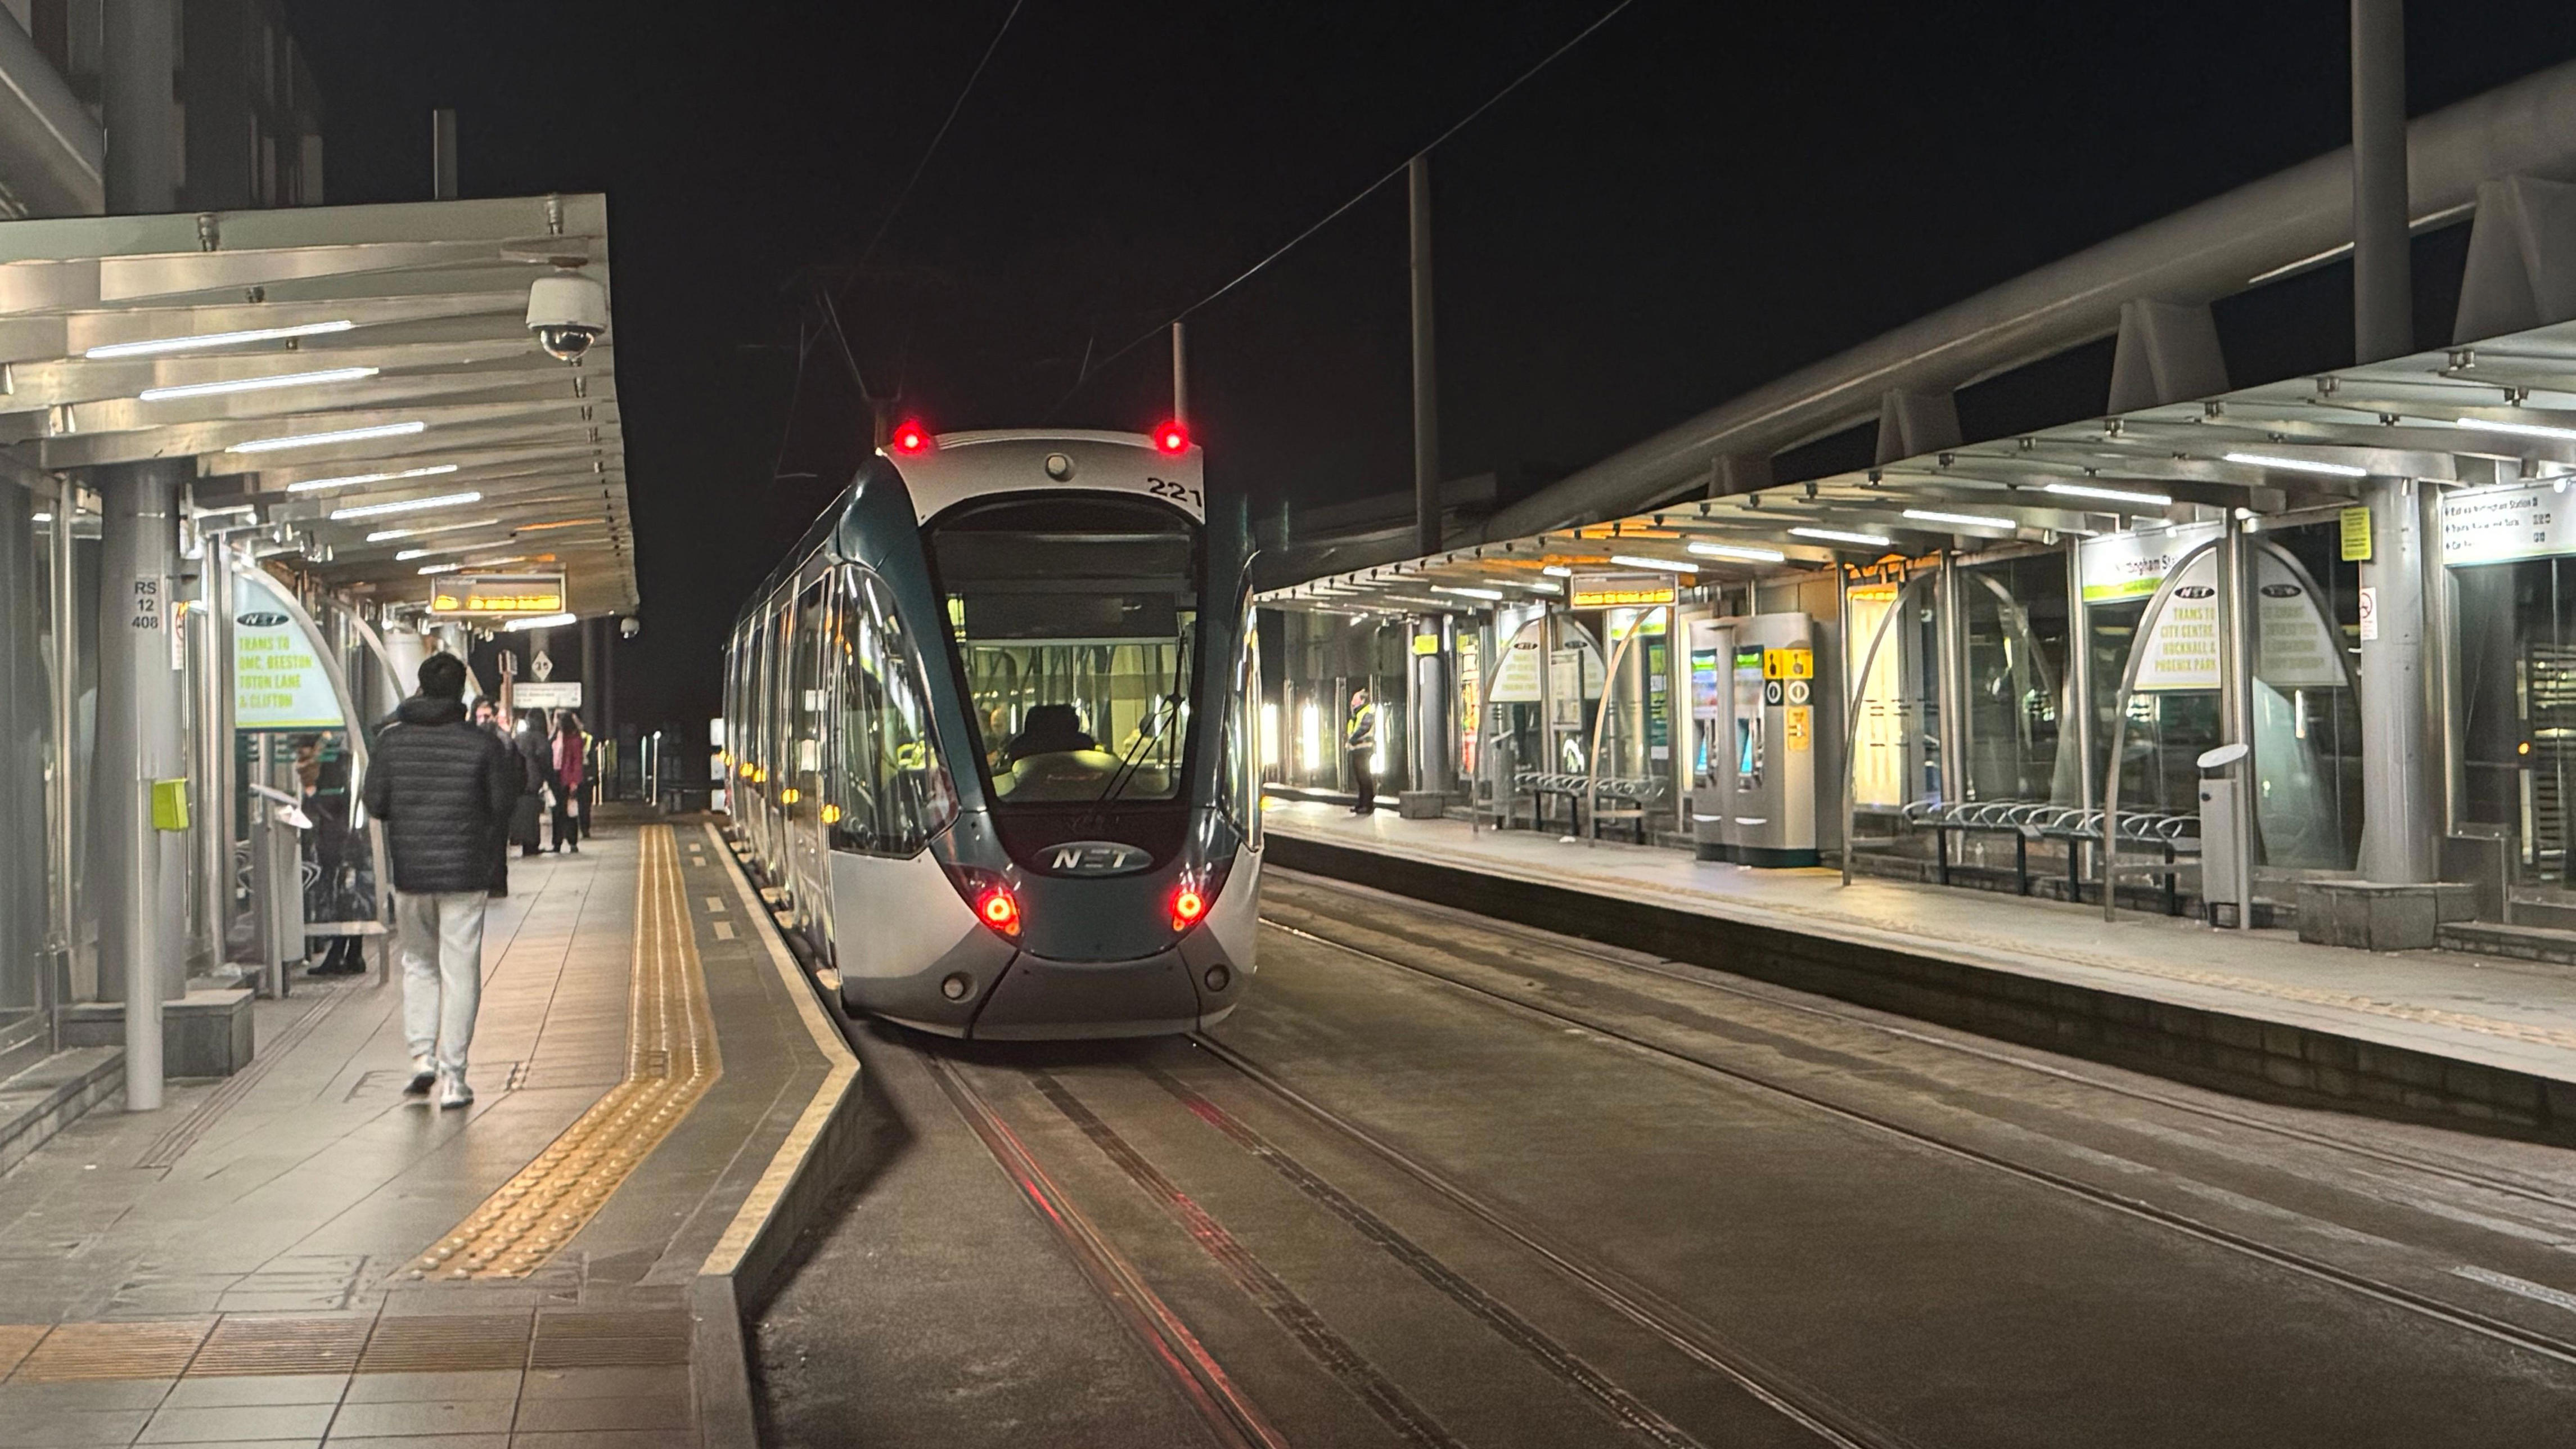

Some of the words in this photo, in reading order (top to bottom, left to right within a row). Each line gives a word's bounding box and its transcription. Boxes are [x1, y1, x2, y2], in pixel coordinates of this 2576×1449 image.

[1147, 478, 1202, 507] 221
[135, 581, 156, 594] RS
[138, 598, 154, 611] 12
[2174, 607, 2203, 620] TRAMS
[131, 616, 158, 628] 408
[2160, 625, 2178, 638] CITY
[238, 636, 273, 650] TRAMS
[274, 674, 301, 688] LANE
[1052, 848, 1136, 869] NET
